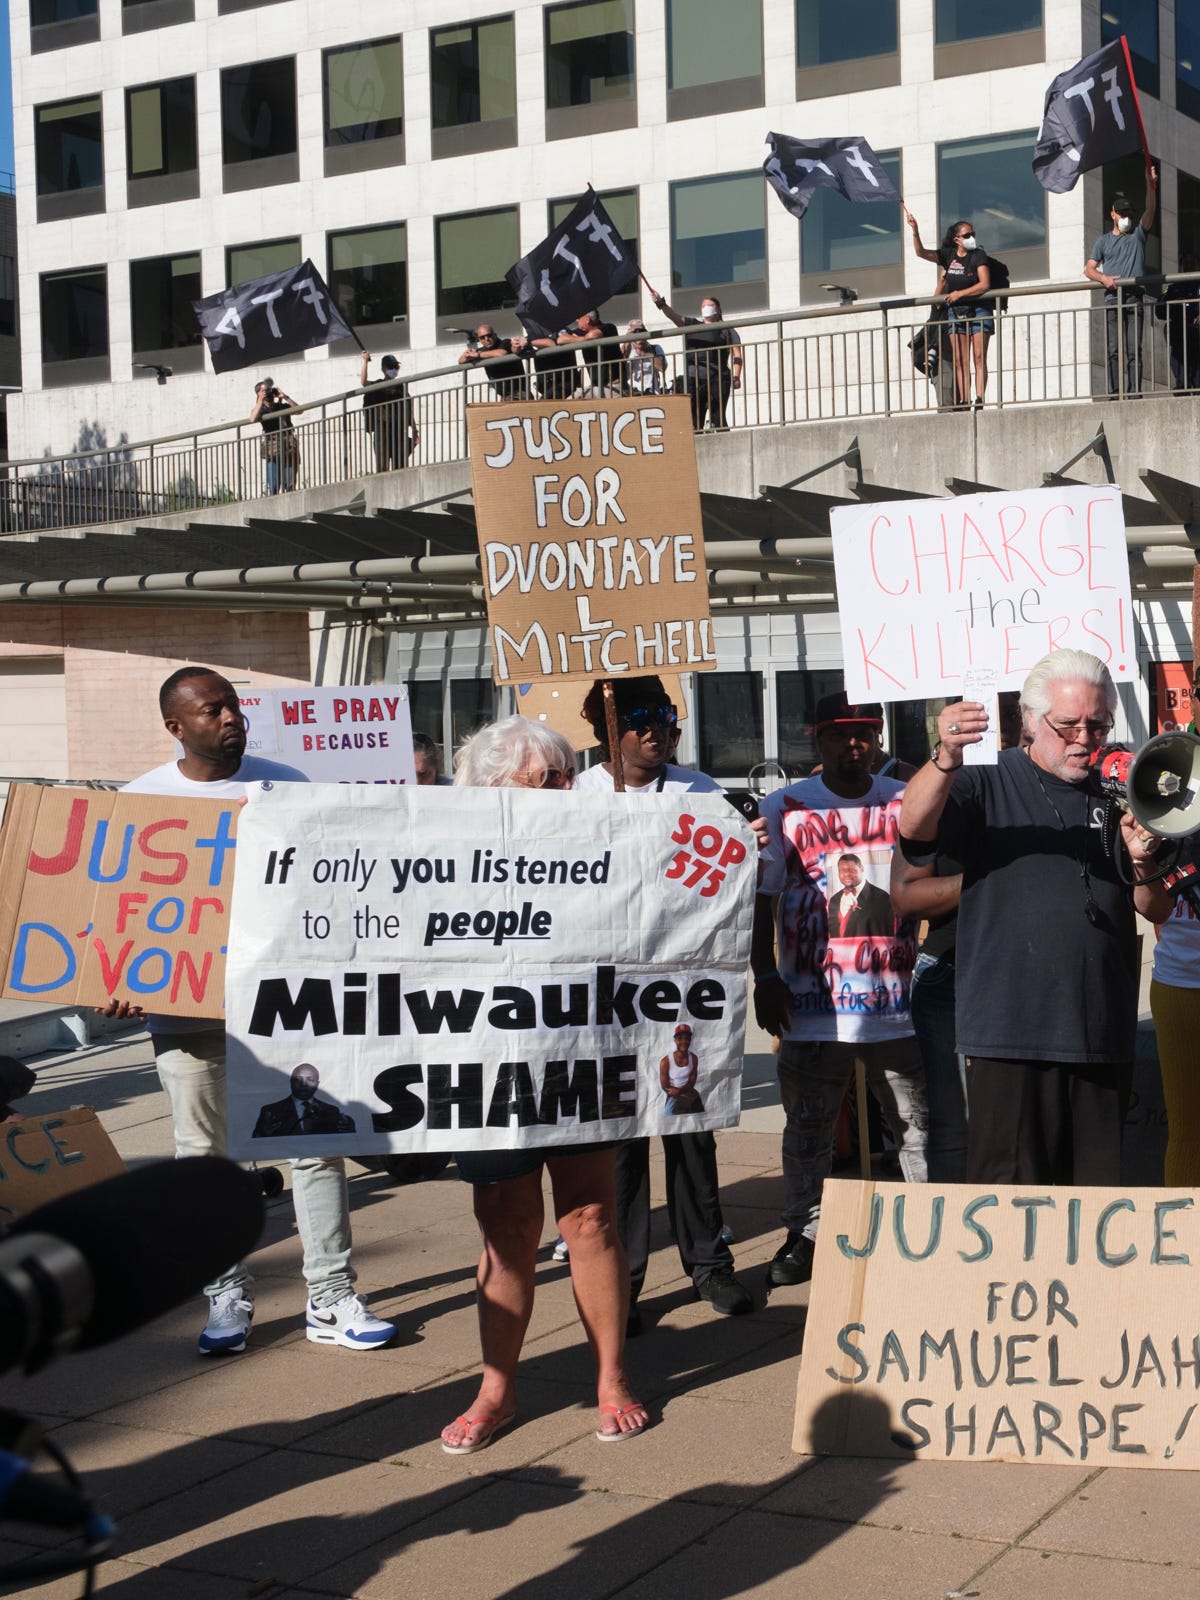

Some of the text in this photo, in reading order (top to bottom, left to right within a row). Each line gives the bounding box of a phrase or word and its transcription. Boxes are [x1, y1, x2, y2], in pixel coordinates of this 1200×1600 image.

[484, 407, 666, 469] JUSTICE
[533, 466, 627, 528] FOR
[485, 534, 698, 598] DVONTAYE
[869, 498, 1117, 596] CHARGE
[576, 595, 613, 633] L
[955, 587, 1049, 628] the
[493, 619, 718, 680] MITCHELL
[281, 696, 400, 726] WE PRAY
[302, 731, 390, 752] BECAUSE
[264, 846, 297, 886] If
[312, 847, 378, 893] only
[391, 856, 456, 894] you
[670, 813, 747, 869] SOP
[664, 849, 727, 898] 575
[302, 901, 552, 947] to the people
[9, 922, 228, 1005] D'VON
[247, 965, 727, 1038] Milwaukee
[370, 1054, 637, 1134] SHAME
[835, 1192, 1195, 1269] JUSTICE
[985, 1278, 1079, 1328] FOR
[825, 1322, 1084, 1391] SAMUEL
